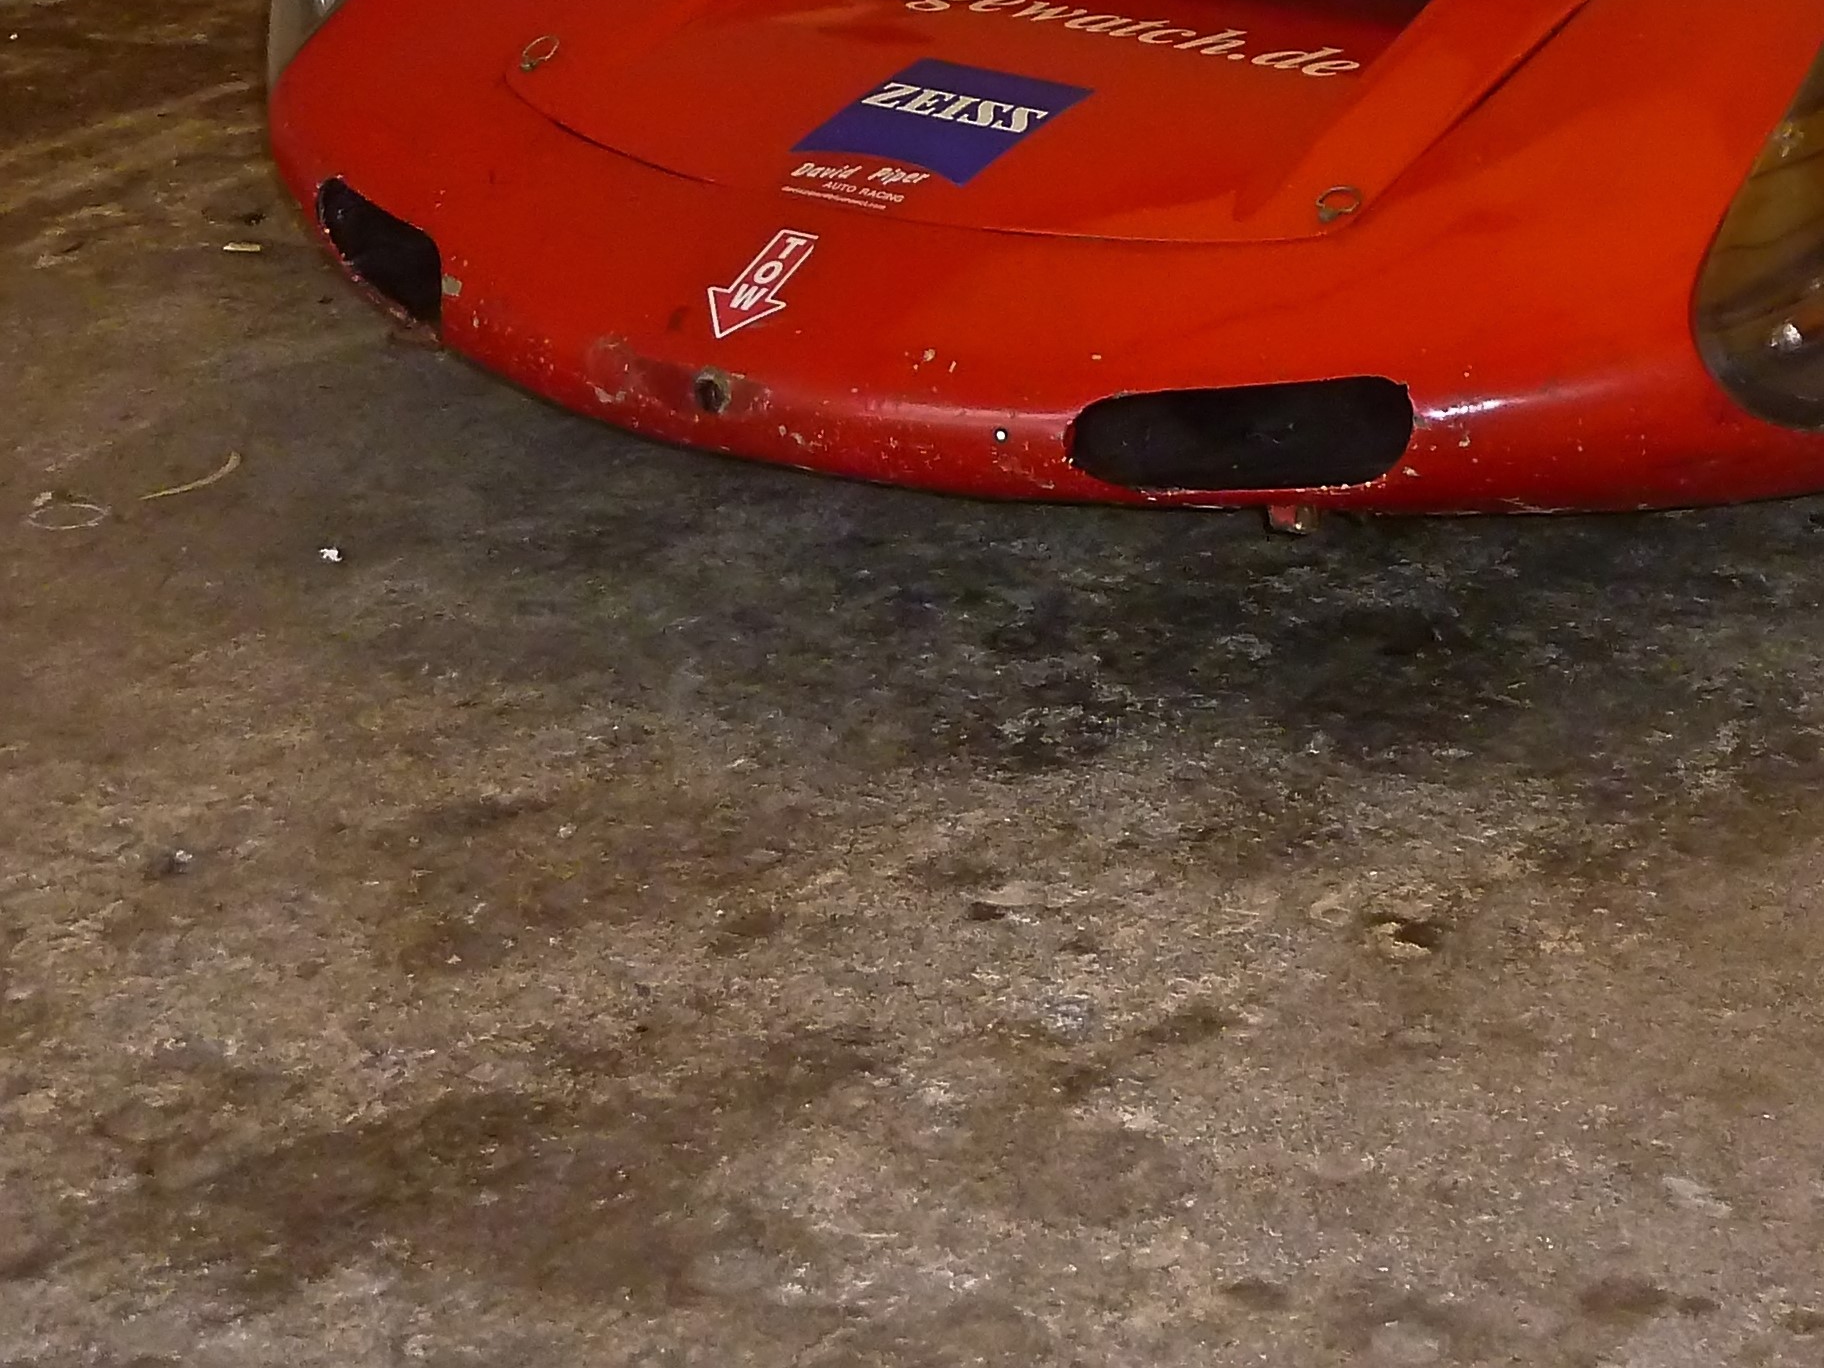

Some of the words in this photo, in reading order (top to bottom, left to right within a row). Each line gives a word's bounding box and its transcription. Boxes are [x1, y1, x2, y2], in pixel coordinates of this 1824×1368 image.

[861, 82, 1050, 134] ZEISS
[791, 163, 863, 180] David
[867, 167, 931, 186] Piper
[822, 181, 858, 194] AUTO
[858, 188, 905, 203] RACING
[729, 236, 808, 311] TOW
